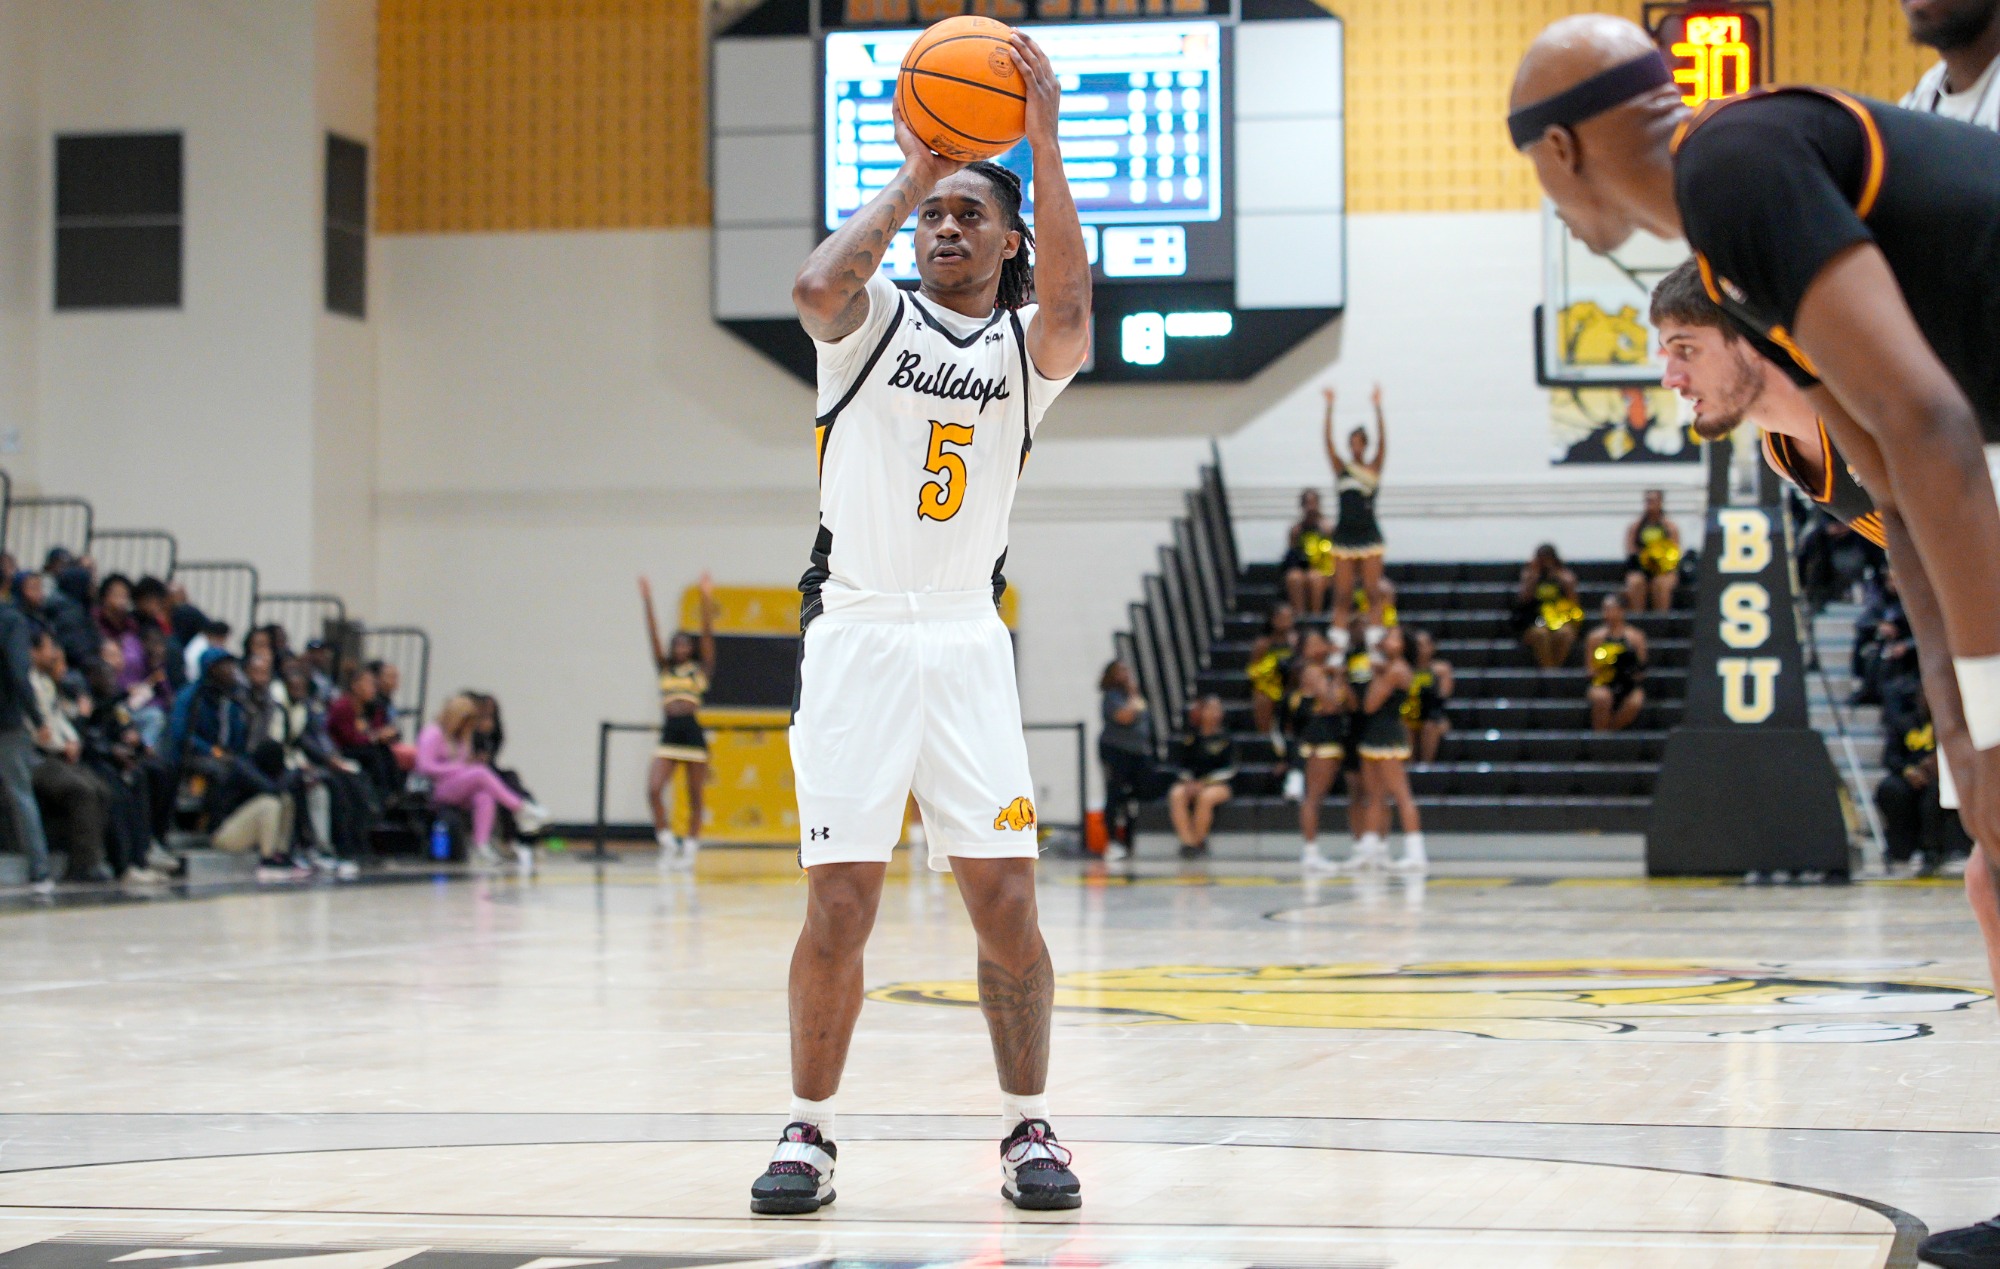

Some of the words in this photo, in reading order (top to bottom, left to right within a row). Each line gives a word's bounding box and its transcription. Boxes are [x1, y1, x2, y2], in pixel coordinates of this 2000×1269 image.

[1671, 42, 1750, 107] 30
[888, 350, 1010, 416] Bulldogs
[917, 420, 974, 521] 5
[1717, 509, 1781, 724] BSU
